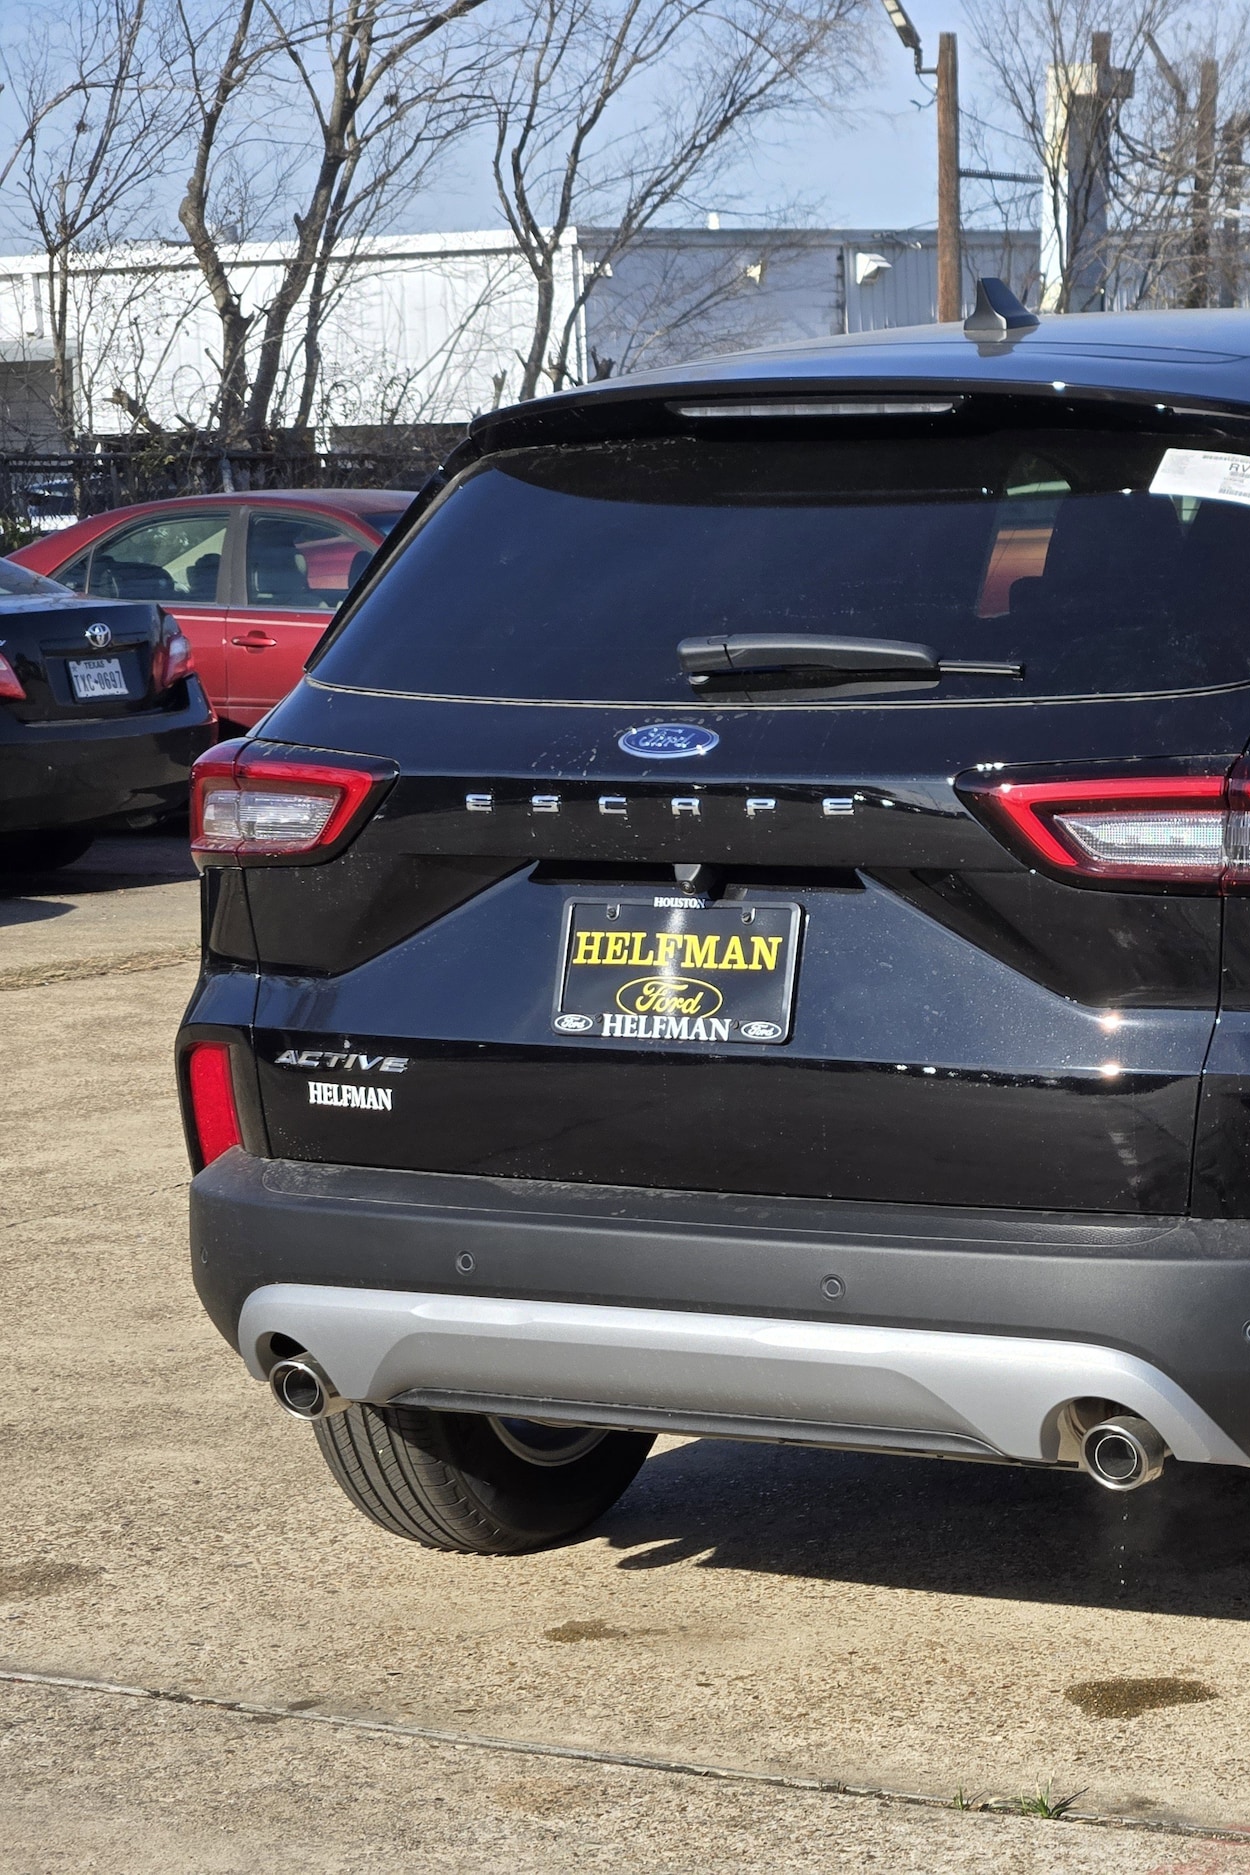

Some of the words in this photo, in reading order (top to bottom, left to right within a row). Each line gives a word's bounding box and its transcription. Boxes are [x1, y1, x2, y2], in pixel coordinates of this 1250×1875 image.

[84, 661, 105, 669] TEXAS
[638, 727, 696, 749] Ford
[466, 793, 855, 816] ESCAPE
[653, 896, 706, 909] HOUSTON
[573, 931, 783, 971] HELFMAN
[635, 980, 704, 1014] Ford
[560, 1016, 586, 1029] Ford
[601, 1013, 733, 1042] HELFMAN
[747, 1024, 775, 1036] Ford
[274, 1050, 411, 1073] ACTIVE
[307, 1081, 393, 1112] HELFMAN
